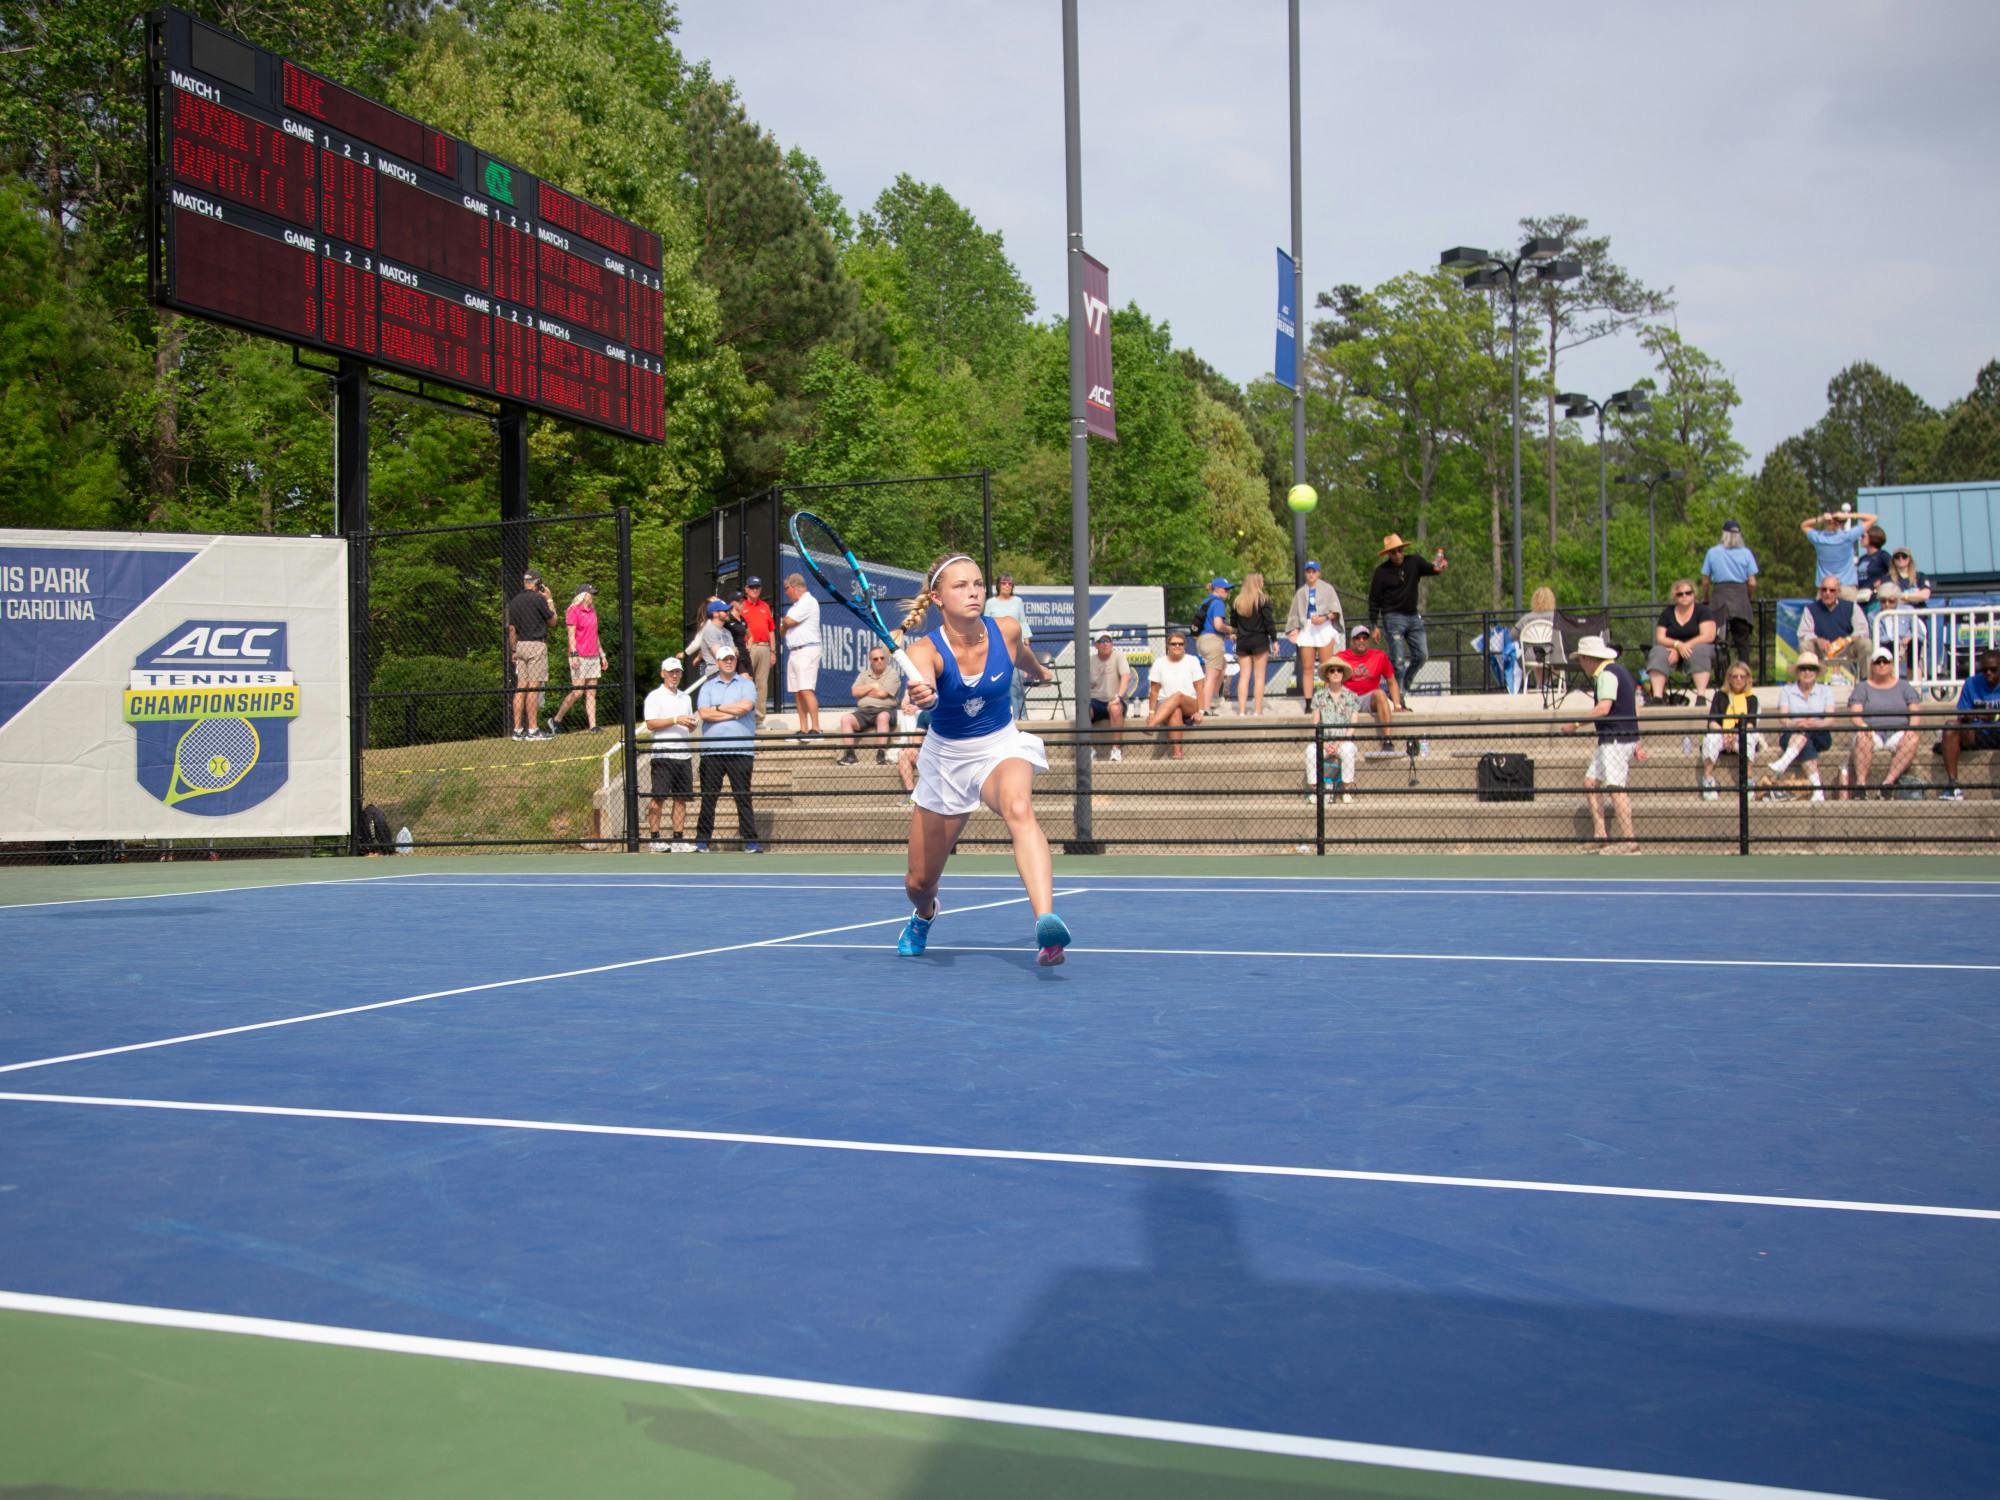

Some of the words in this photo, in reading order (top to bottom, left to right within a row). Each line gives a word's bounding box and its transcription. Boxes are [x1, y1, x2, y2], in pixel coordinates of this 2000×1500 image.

[171, 70, 211, 99] MATCH
[214, 88, 220, 102] 1
[282, 117, 314, 142] GAME
[323, 134, 329, 148] 1
[344, 143, 351, 157] 2
[362, 150, 369, 165] 3
[378, 158, 409, 182] MATCH
[410, 172, 416, 185] 2
[172, 189, 213, 216] MATCH
[215, 204, 222, 219] 4
[463, 194, 488, 215] GAME
[495, 208, 499, 220] 1
[511, 215, 516, 227] 2
[524, 220, 529, 233] 3
[284, 228, 315, 251] GAME
[324, 243, 329, 256] 1
[345, 250, 351, 263] 2
[364, 257, 370, 270] 3
[538, 227, 563, 247] MATCH
[564, 238, 568, 250] 3
[379, 262, 410, 284] MATCH
[412, 274, 417, 287] 5
[605, 256, 624, 274] GAME
[630, 268, 634, 278] 1
[642, 273, 647, 284] 2
[655, 278, 659, 289] 3
[464, 293, 489, 312] GAME
[495, 304, 500, 316] 1
[512, 310, 517, 322] 2
[527, 315, 532, 327] 3
[1083, 291, 1108, 335] VT
[539, 319, 564, 338] MATCH
[565, 328, 569, 340] 6
[606, 344, 625, 360] GAME
[631, 353, 635, 363] 1
[644, 358, 648, 368] 2
[656, 362, 660, 373] 3
[1088, 385, 1111, 408] ACC
[30, 567, 91, 593] PARK
[7, 599, 95, 620] CAROLINA
[1052, 603, 1075, 615] PARK
[160, 627, 280, 657] ACC
[143, 674, 277, 686] TENNIS
[130, 692, 295, 716] CHAMPIONSHIPS
